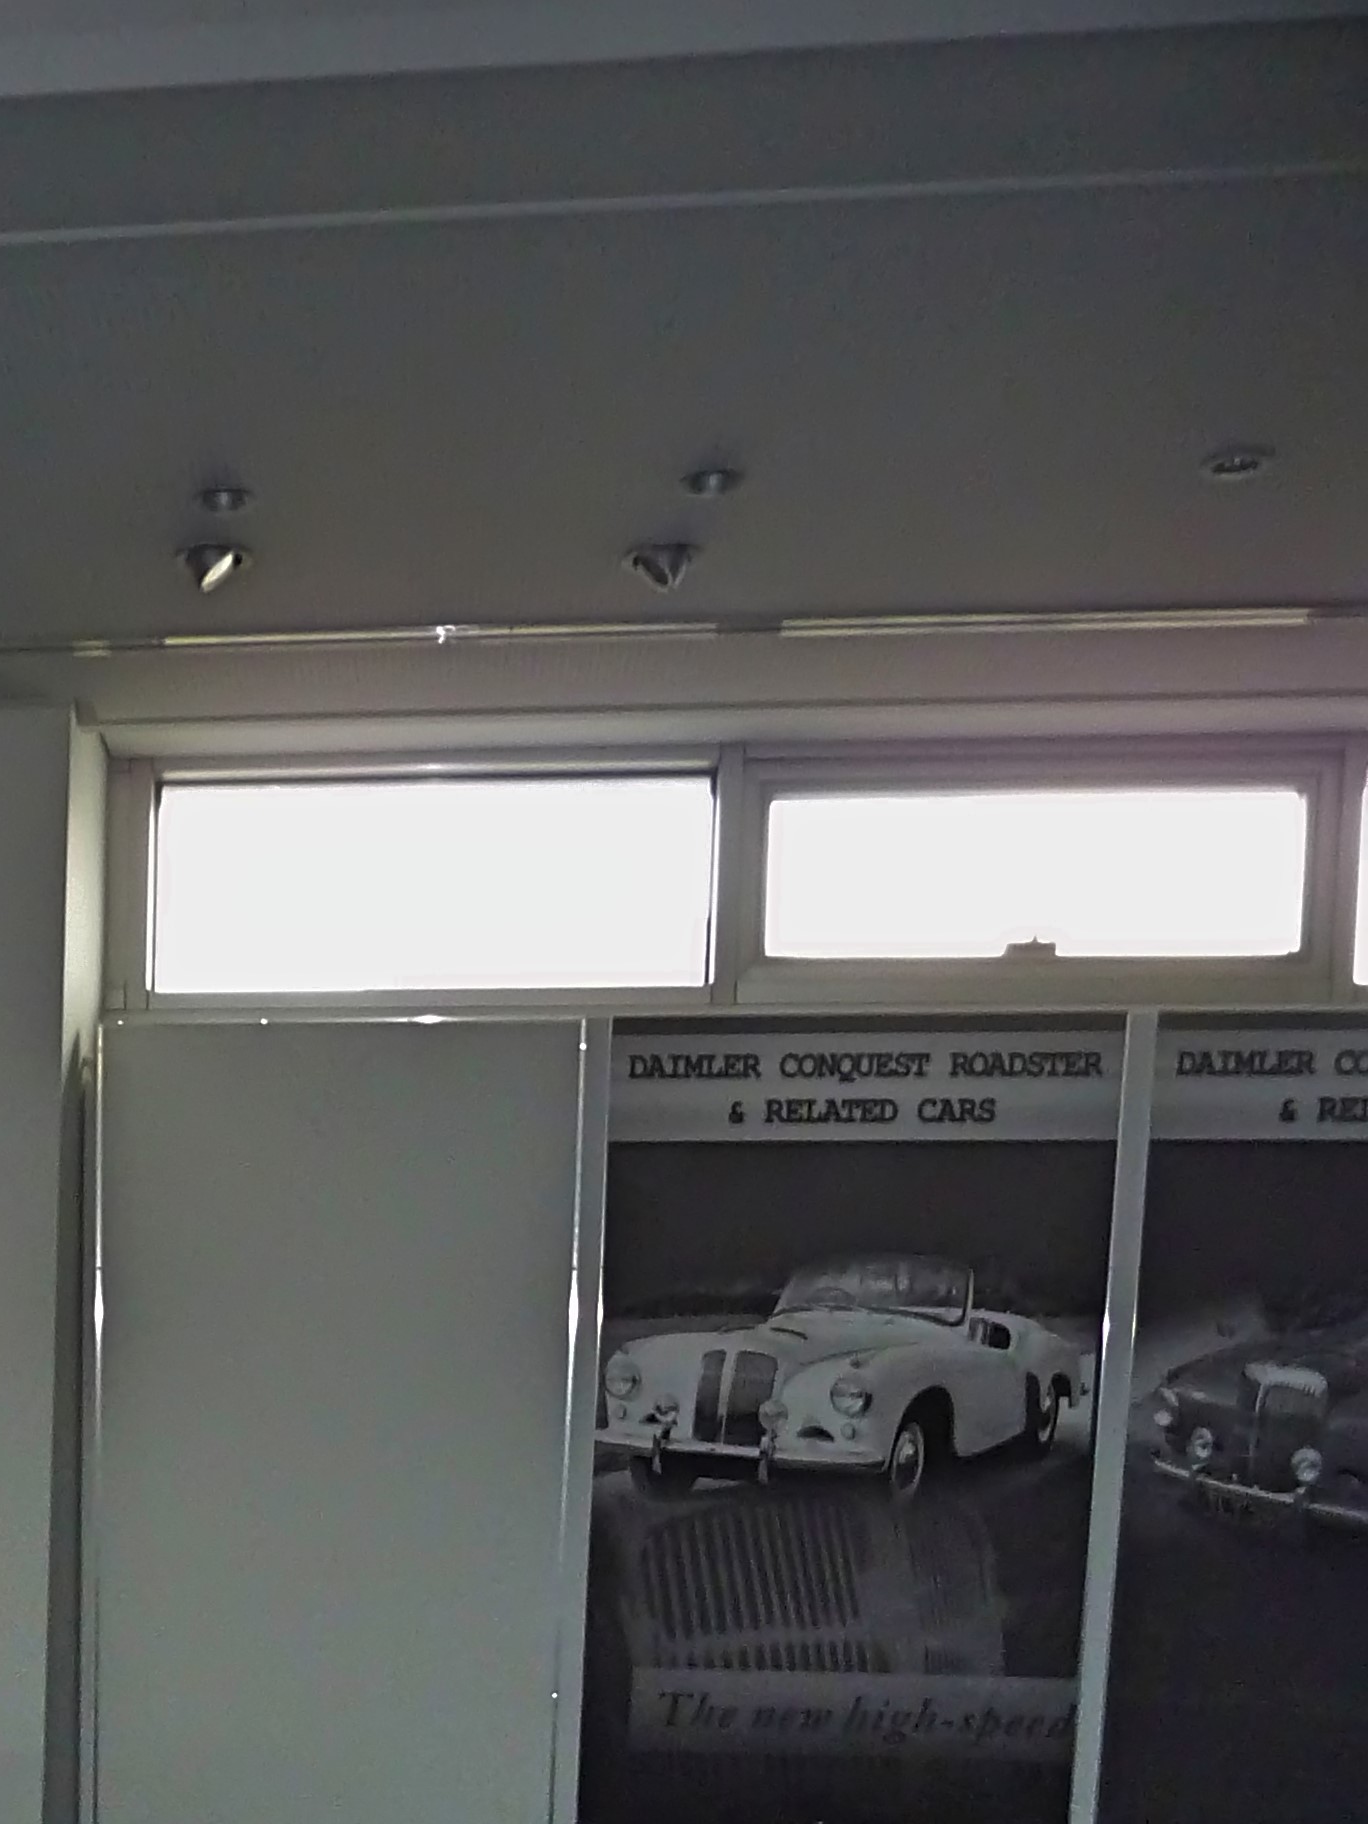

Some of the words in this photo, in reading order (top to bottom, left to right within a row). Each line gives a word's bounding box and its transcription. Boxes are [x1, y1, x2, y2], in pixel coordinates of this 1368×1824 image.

[628, 1053, 761, 1079] DAIMLER
[780, 1052, 930, 1083] CONQUEST
[949, 1051, 1102, 1077] ROADSTER
[1176, 1050, 1316, 1076] DAIMLER
[729, 1102, 744, 1124] &
[765, 1099, 898, 1123] RELATED
[918, 1098, 996, 1123] CARS
[658, 1691, 738, 1728] The
